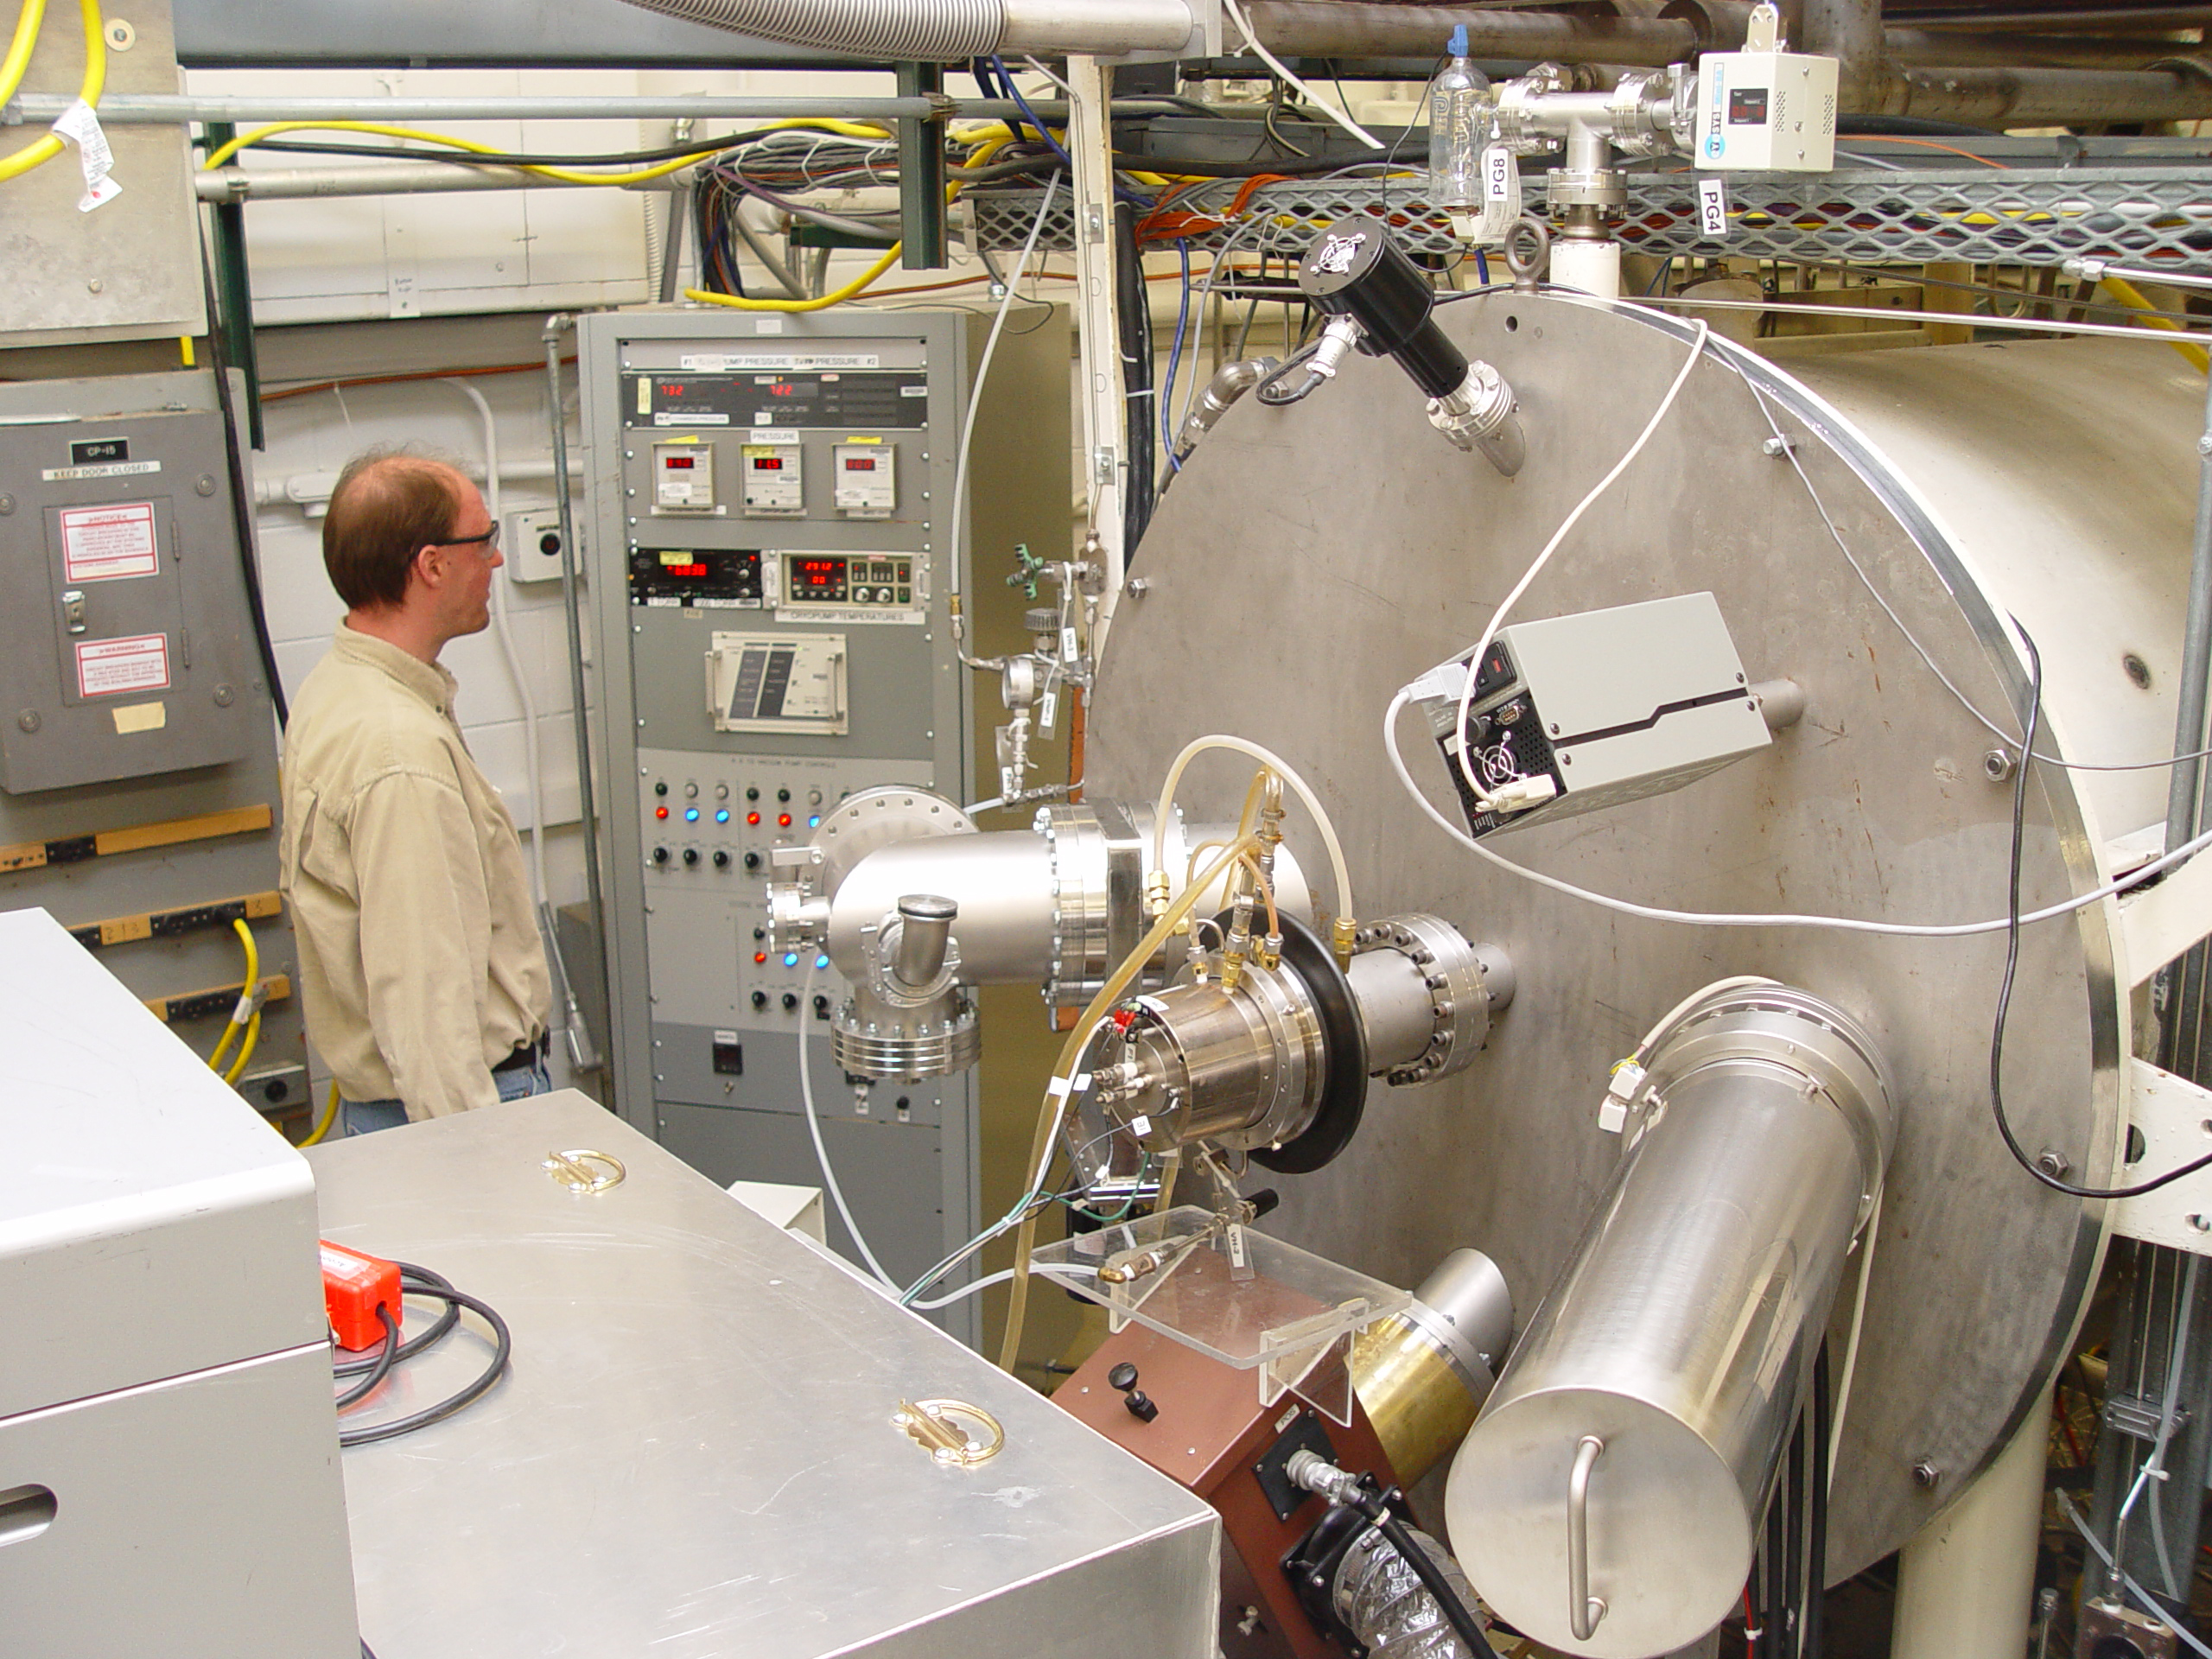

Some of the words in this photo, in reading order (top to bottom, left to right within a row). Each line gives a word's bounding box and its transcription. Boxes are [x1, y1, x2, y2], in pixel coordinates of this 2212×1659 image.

[1492, 158, 1505, 195] PG8
[1704, 191, 1721, 232] PG4
[745, 357, 786, 366] PRESSURE
[816, 357, 860, 366] PRESSURE
[753, 432, 796, 441] PRESSURE
[87, 445, 117, 457] CP-15
[54, 469, 79, 479] KEEP
[81, 467, 109, 477] DOOR
[111, 463, 149, 474] CLOSED
[1230, 1231, 1240, 1255] VH-2
